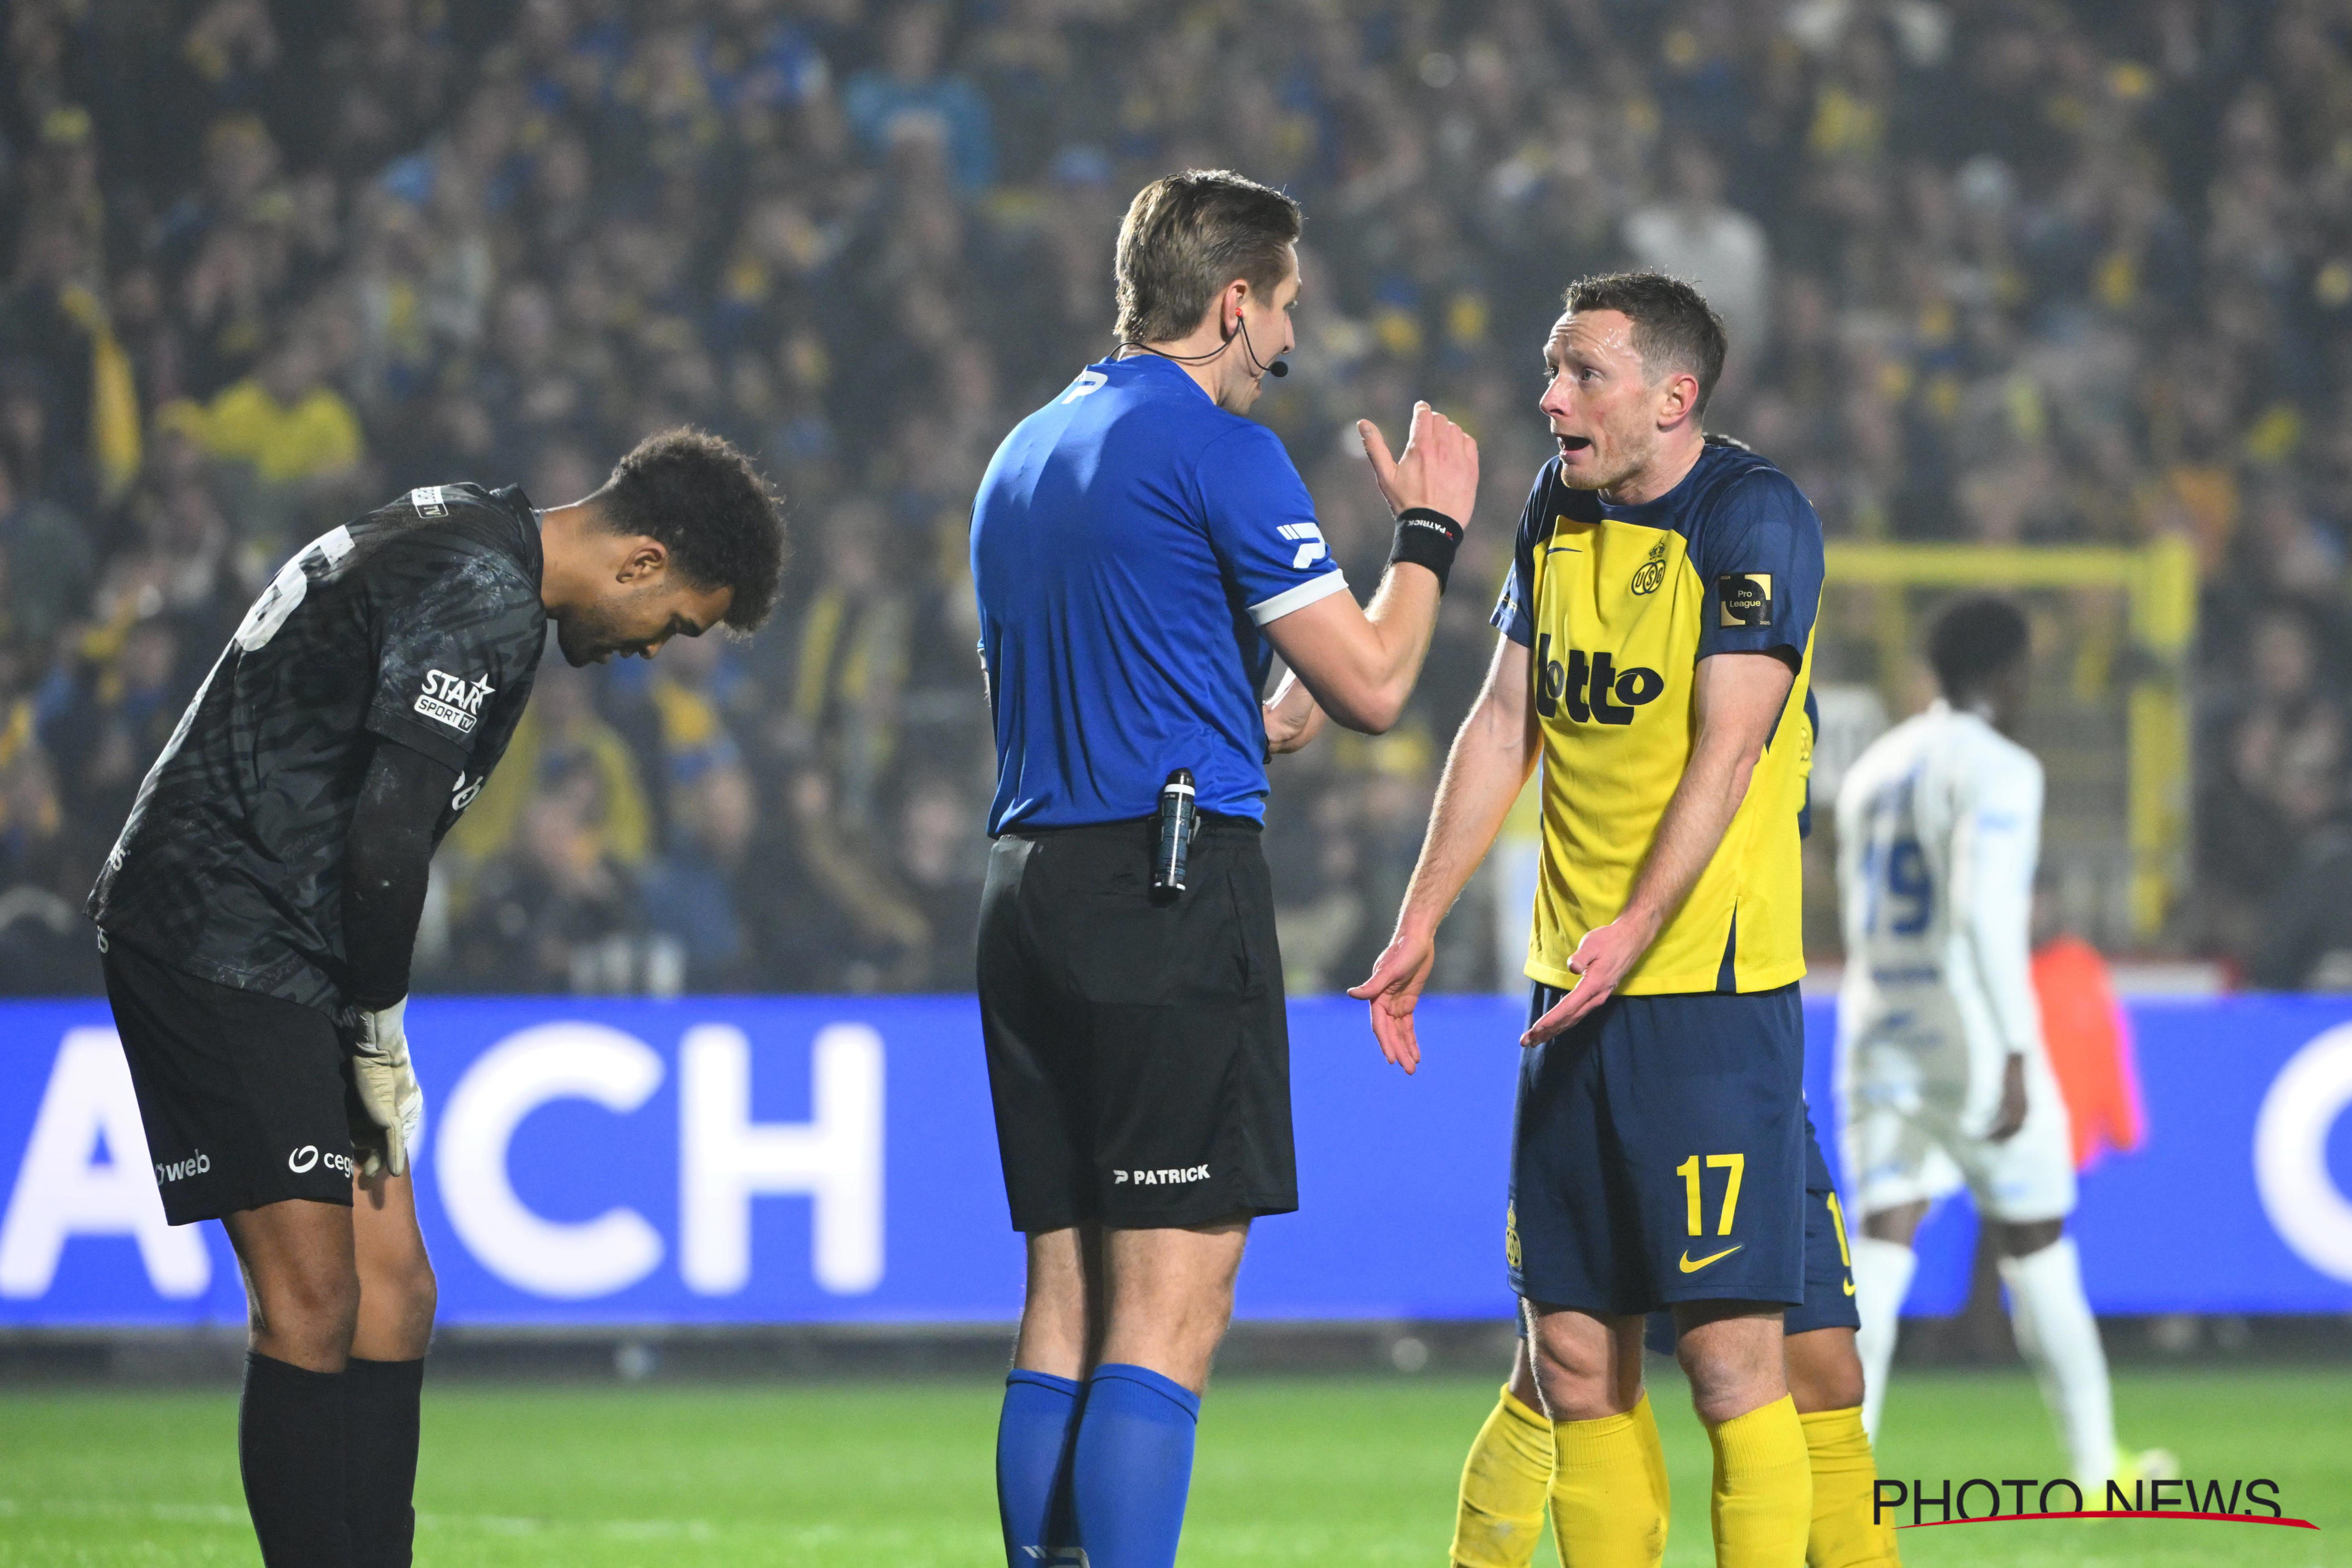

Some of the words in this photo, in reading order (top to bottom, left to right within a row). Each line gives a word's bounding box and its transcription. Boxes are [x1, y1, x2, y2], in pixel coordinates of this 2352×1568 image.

[1408, 519, 1446, 534] PATRICK
[1730, 600, 1761, 609] League
[422, 669, 479, 715] STAR
[1536, 633, 1664, 725] lotto
[418, 699, 460, 723] SPORT
[461, 717, 474, 729] TV
[0, 1021, 887, 1299] ACH
[1133, 1164, 1211, 1185] PATRICK
[1677, 1153, 1744, 1237] 17
